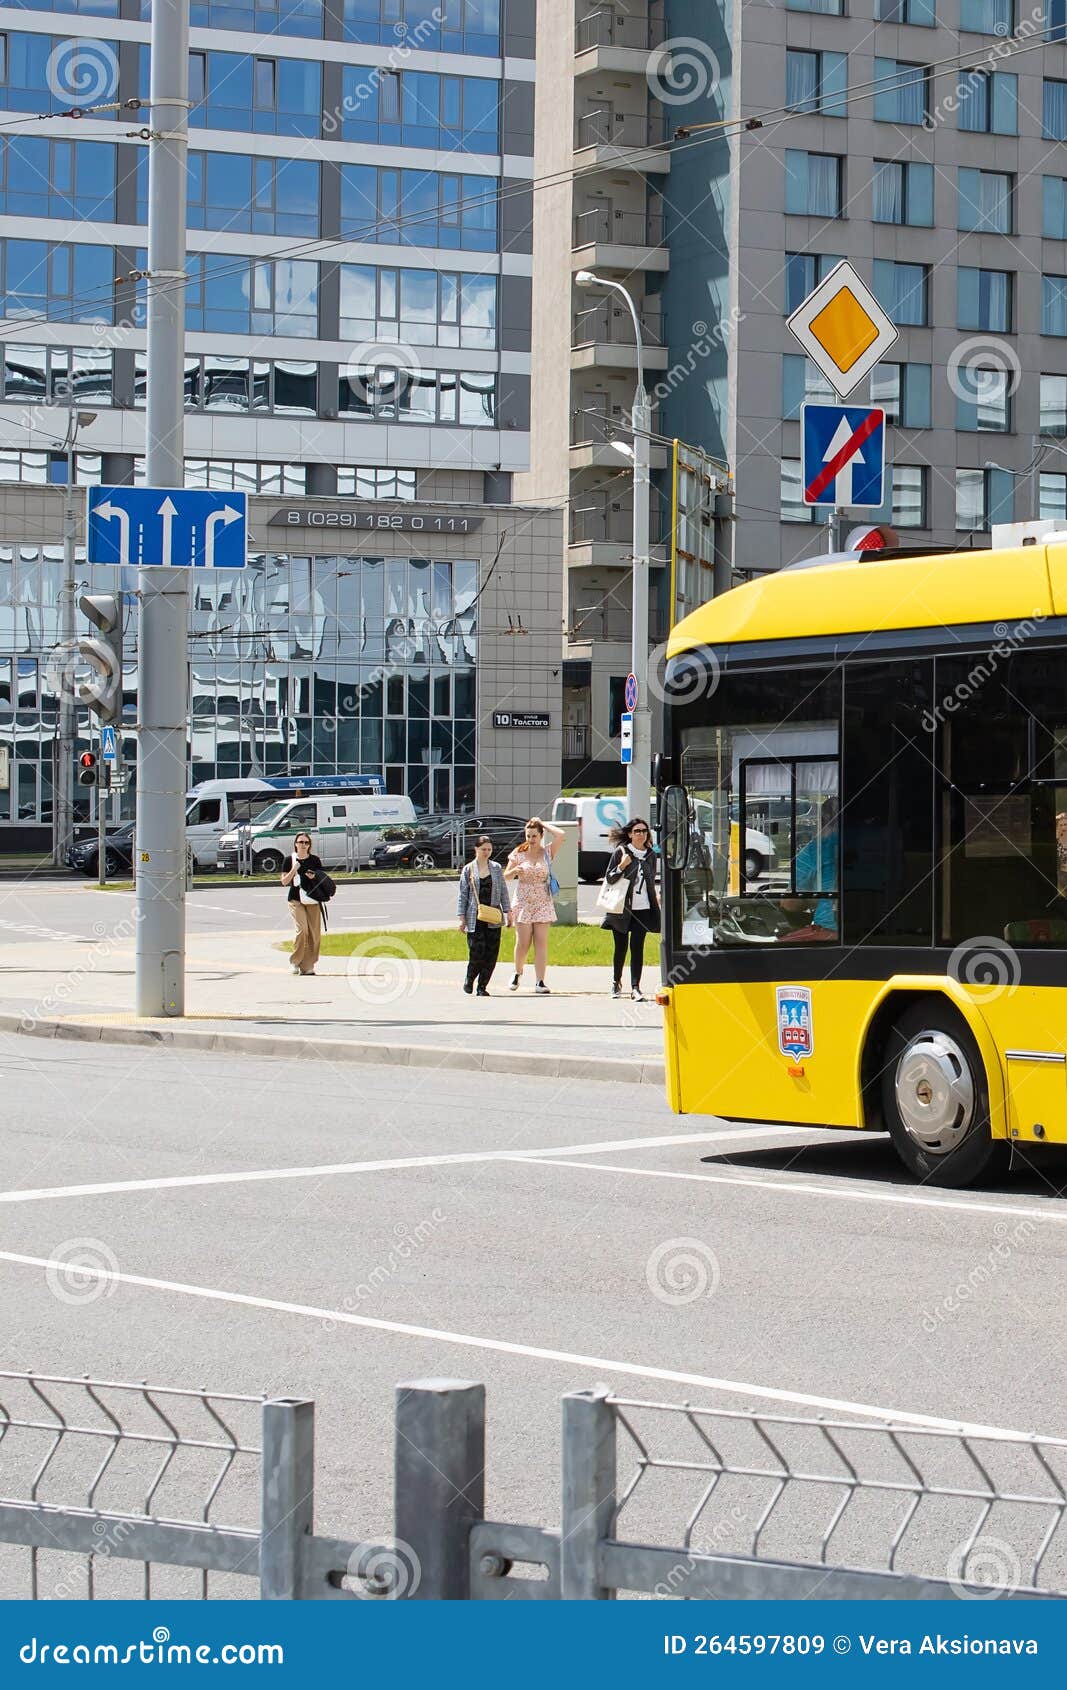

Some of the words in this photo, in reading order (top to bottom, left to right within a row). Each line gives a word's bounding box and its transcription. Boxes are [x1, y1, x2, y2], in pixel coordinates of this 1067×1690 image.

[287, 511, 301, 524] 8
[307, 511, 357, 527] (029)
[366, 514, 403, 529] 182
[411, 516, 424, 529] 0
[434, 518, 469, 531] 111
[496, 714, 510, 725] 10
[512, 718, 548, 726] Толстого
